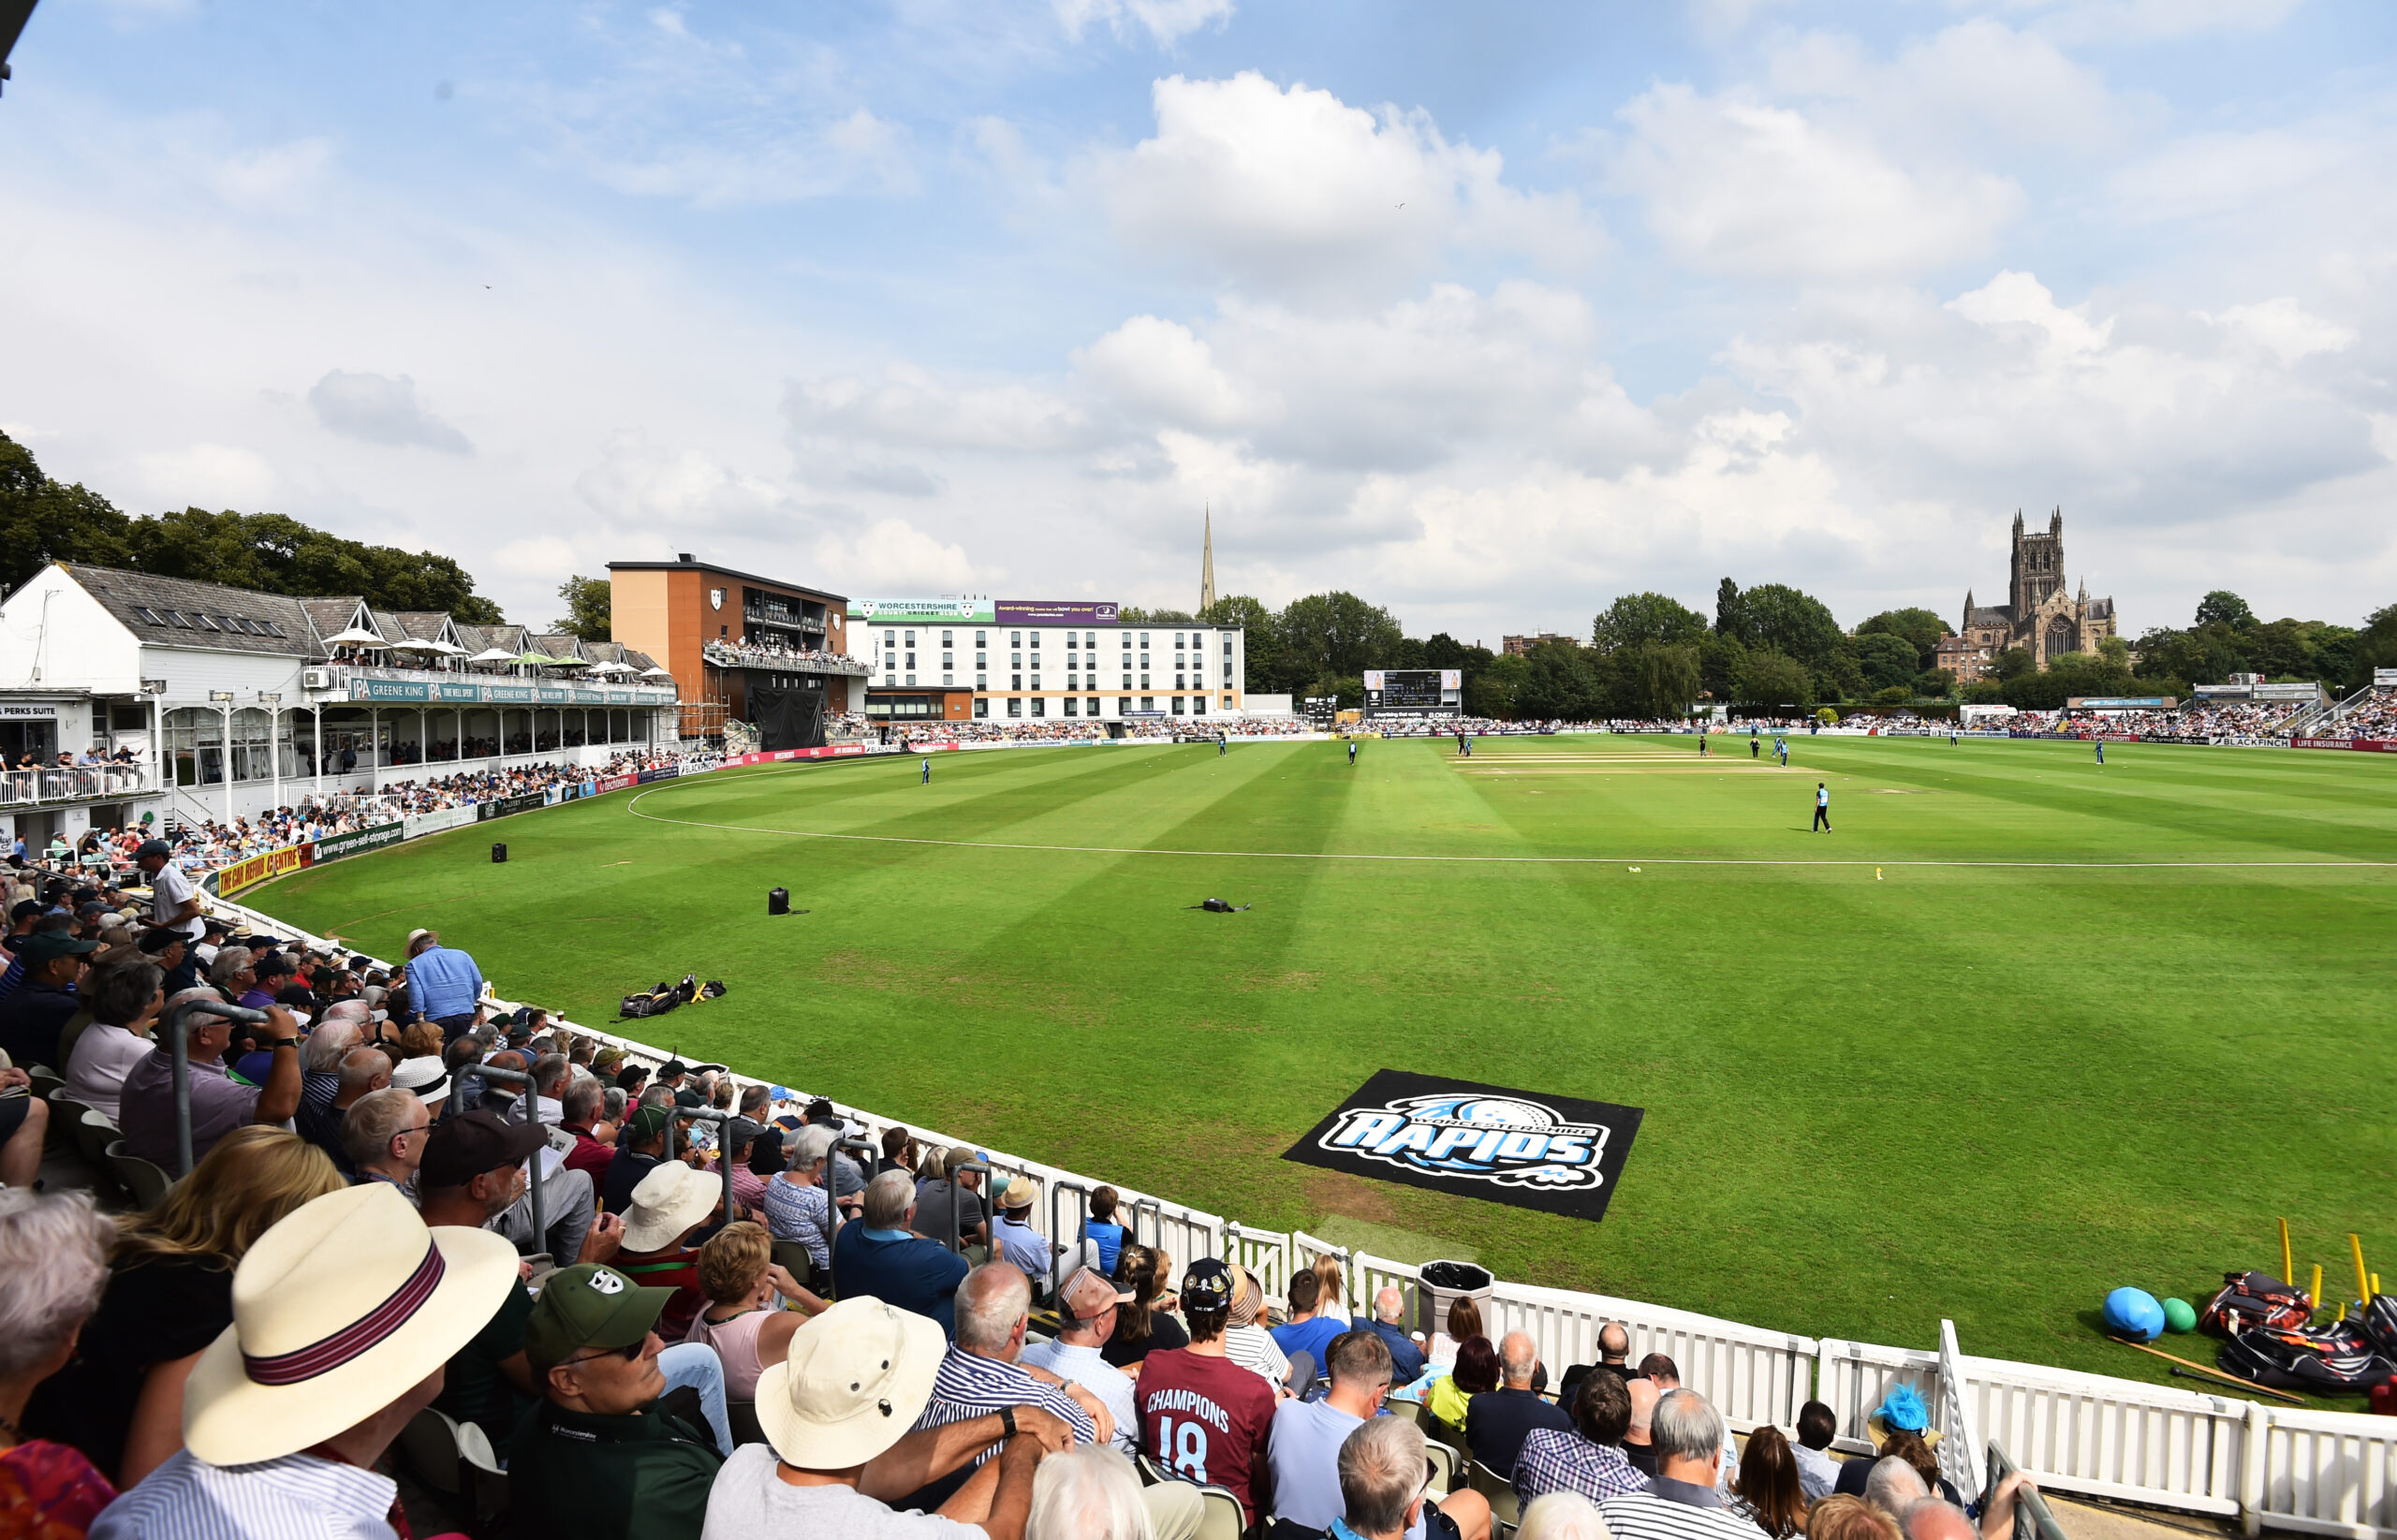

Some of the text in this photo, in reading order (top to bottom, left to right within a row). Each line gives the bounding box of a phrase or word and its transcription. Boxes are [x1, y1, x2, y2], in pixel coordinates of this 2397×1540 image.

[353, 680, 424, 699] IPA GREENE KING
[428, 683, 442, 701] IPA
[481, 686, 528, 702] IPA GREENE KING
[4, 707, 56, 715] PERKS SUITE
[2224, 738, 2288, 747] BLACKFINCH
[323, 828, 403, 856] www.green-self-storage.com
[220, 872, 232, 894] THE
[231, 866, 244, 888] CAR
[267, 849, 298, 873] CENTRE
[1414, 1117, 1597, 1136] WORCESTERSHIRE
[1336, 1112, 1595, 1164] RAPIDS
[1147, 1388, 1229, 1434] CHAMPIONS
[1159, 1415, 1208, 1485] 18
